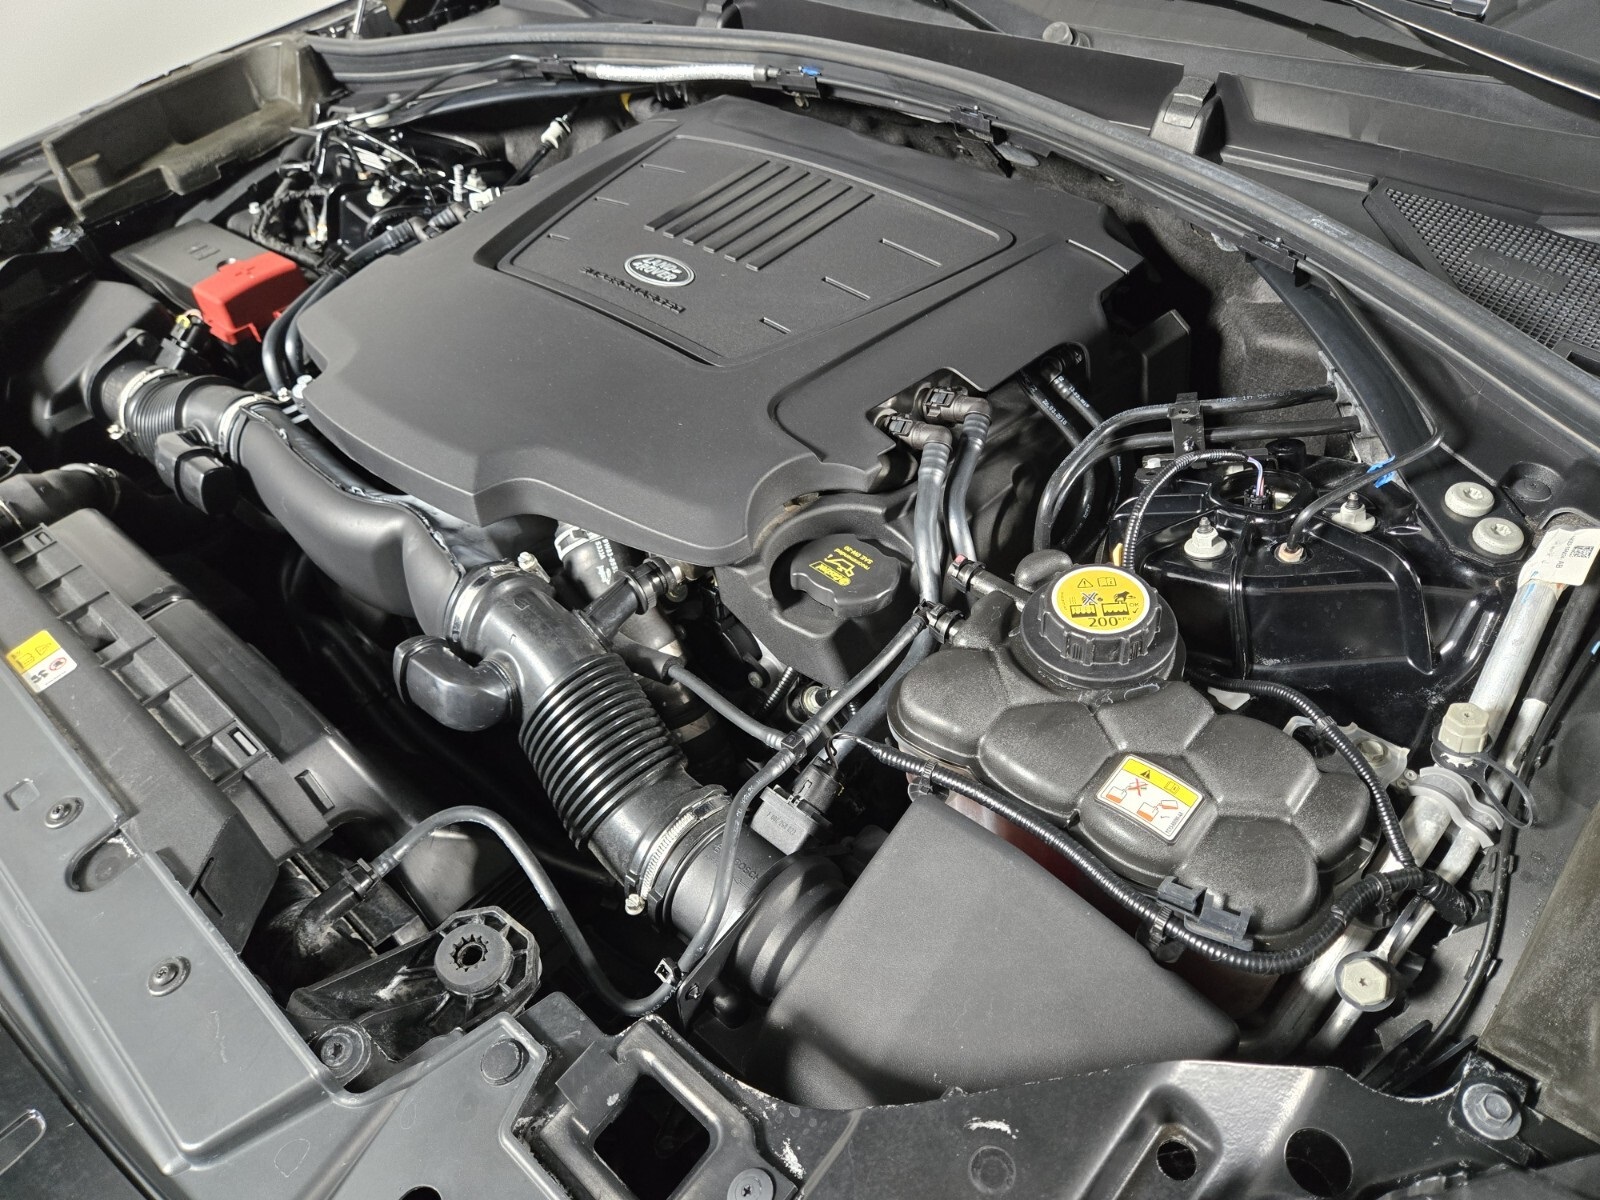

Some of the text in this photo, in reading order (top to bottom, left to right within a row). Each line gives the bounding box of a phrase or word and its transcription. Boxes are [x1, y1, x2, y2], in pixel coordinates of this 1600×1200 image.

[642, 258, 678, 271] LAND
[634, 262, 678, 281] ROVER
[833, 548, 871, 570] recommended
[860, 555, 873, 565] SAE
[1088, 617, 1118, 628] 200
